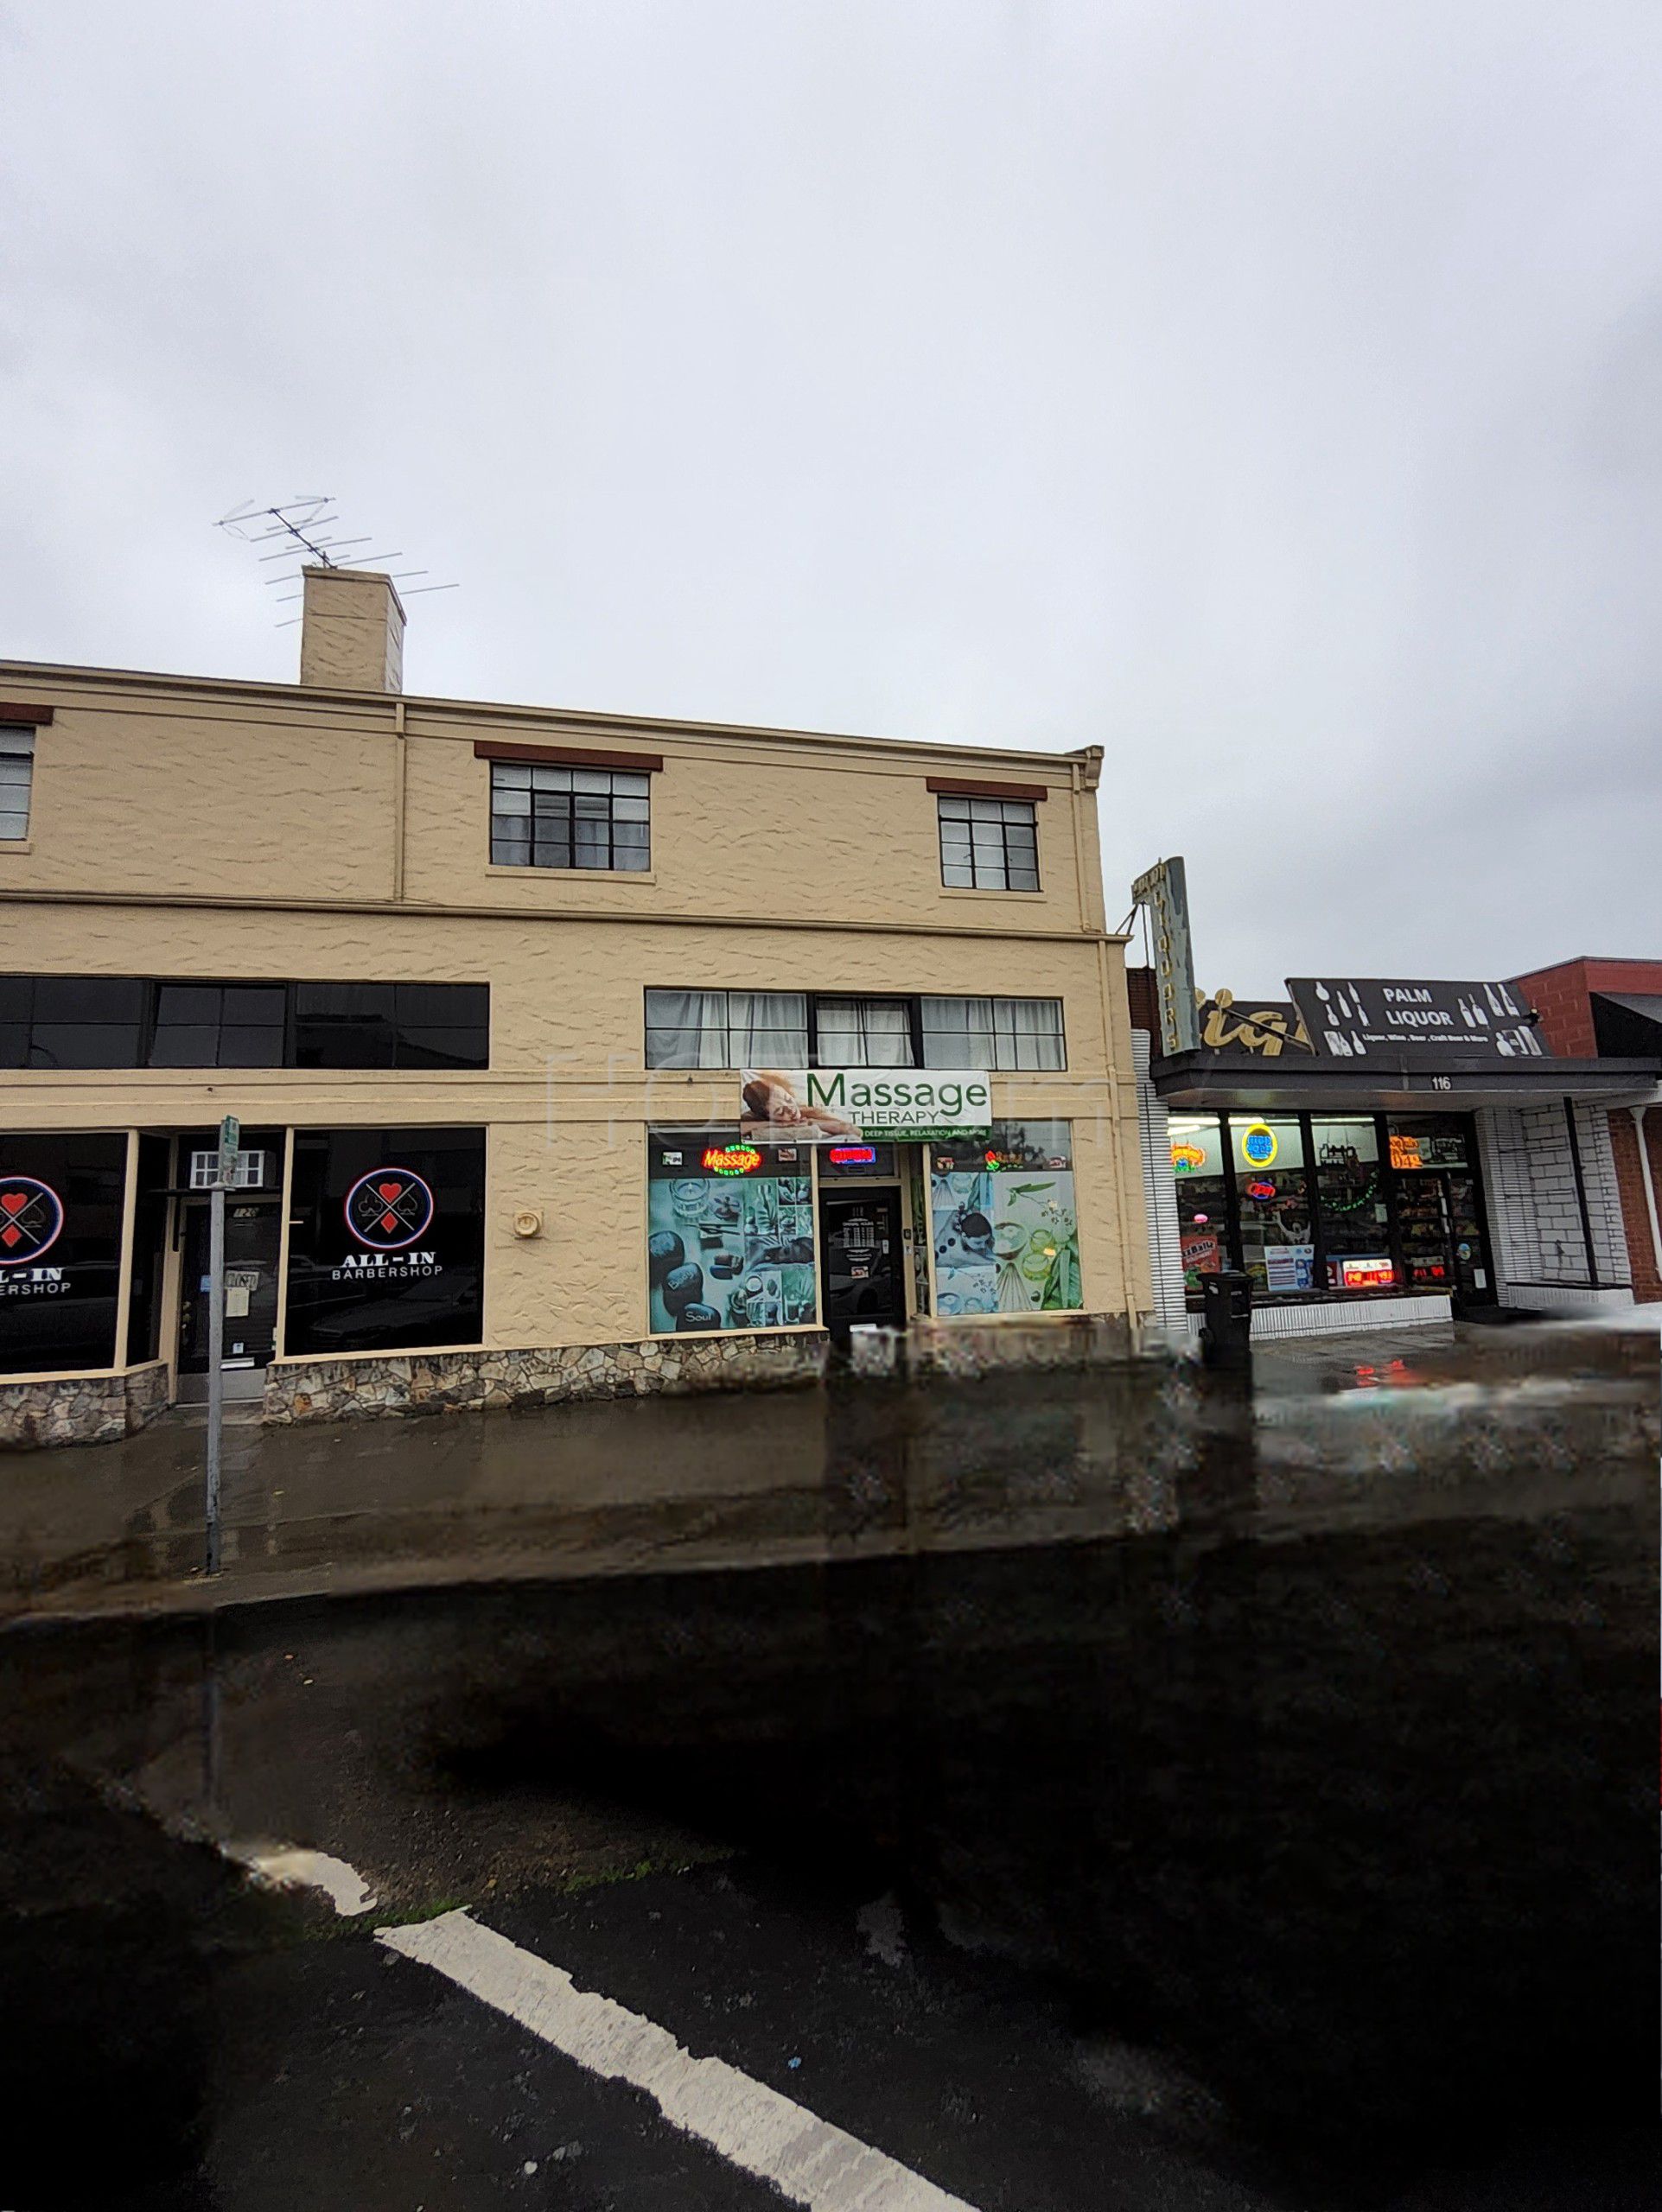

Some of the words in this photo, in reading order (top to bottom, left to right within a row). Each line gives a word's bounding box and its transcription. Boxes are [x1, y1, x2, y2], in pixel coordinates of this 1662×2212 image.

[1383, 988, 1432, 1002] PALM
[1385, 1010, 1454, 1027] LIQUOR
[1432, 1076, 1451, 1090] 116
[806, 1072, 987, 1116] Massage
[849, 1110, 940, 1124] THERAPY
[704, 1150, 762, 1170] Massage
[341, 1251, 436, 1268] ALL-IN
[332, 1265, 443, 1281] BARBERSHOP
[685, 1312, 712, 1322] Soul
